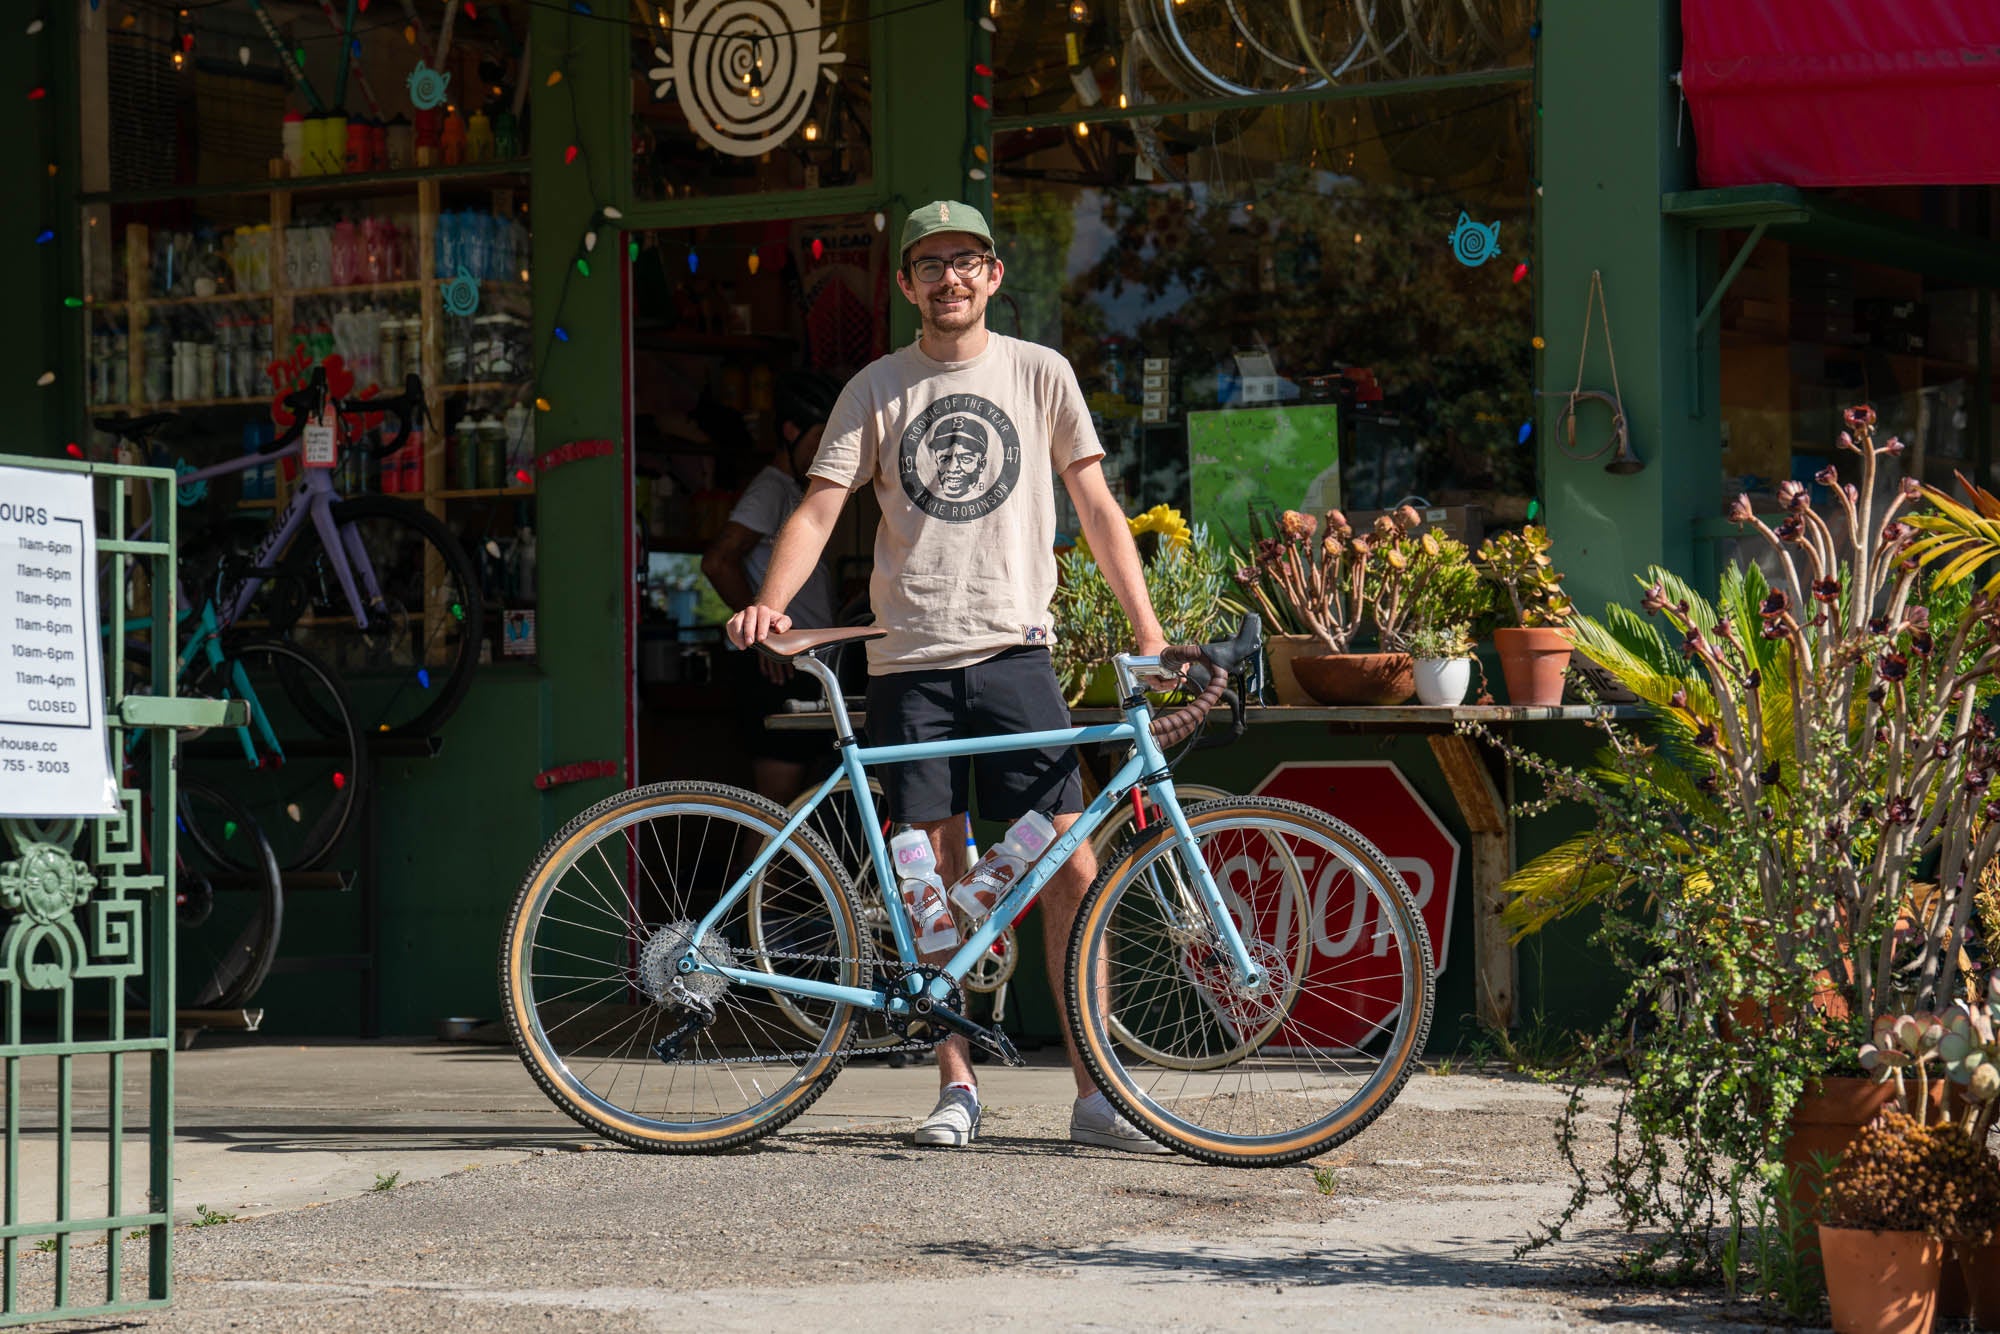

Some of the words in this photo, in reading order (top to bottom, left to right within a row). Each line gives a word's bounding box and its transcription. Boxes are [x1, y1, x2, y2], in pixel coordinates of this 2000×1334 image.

[908, 406, 942, 442] ROOKIE
[944, 397, 958, 410] OF
[964, 397, 985, 411] THE
[987, 407, 1010, 433] YEAR
[1006, 446, 1020, 464] 47
[901, 455, 913, 474] 19
[952, 482, 1009, 518] ROBINSON
[0, 503, 47, 526] OURS
[18, 537, 72, 556] 11am-6pm
[17, 563, 71, 582] 11am-6pm
[16, 591, 71, 609] 11am-6pm
[15, 618, 72, 636] 11am-6pm
[12, 644, 74, 662] 10am-6pm
[16, 671, 76, 689] 11am-4pm
[28, 699, 77, 714] CLOSED
[0, 737, 58, 752] house.cc
[2, 759, 26, 772] 755
[37, 760, 70, 774] 3003
[1214, 856, 1434, 958] STOP
